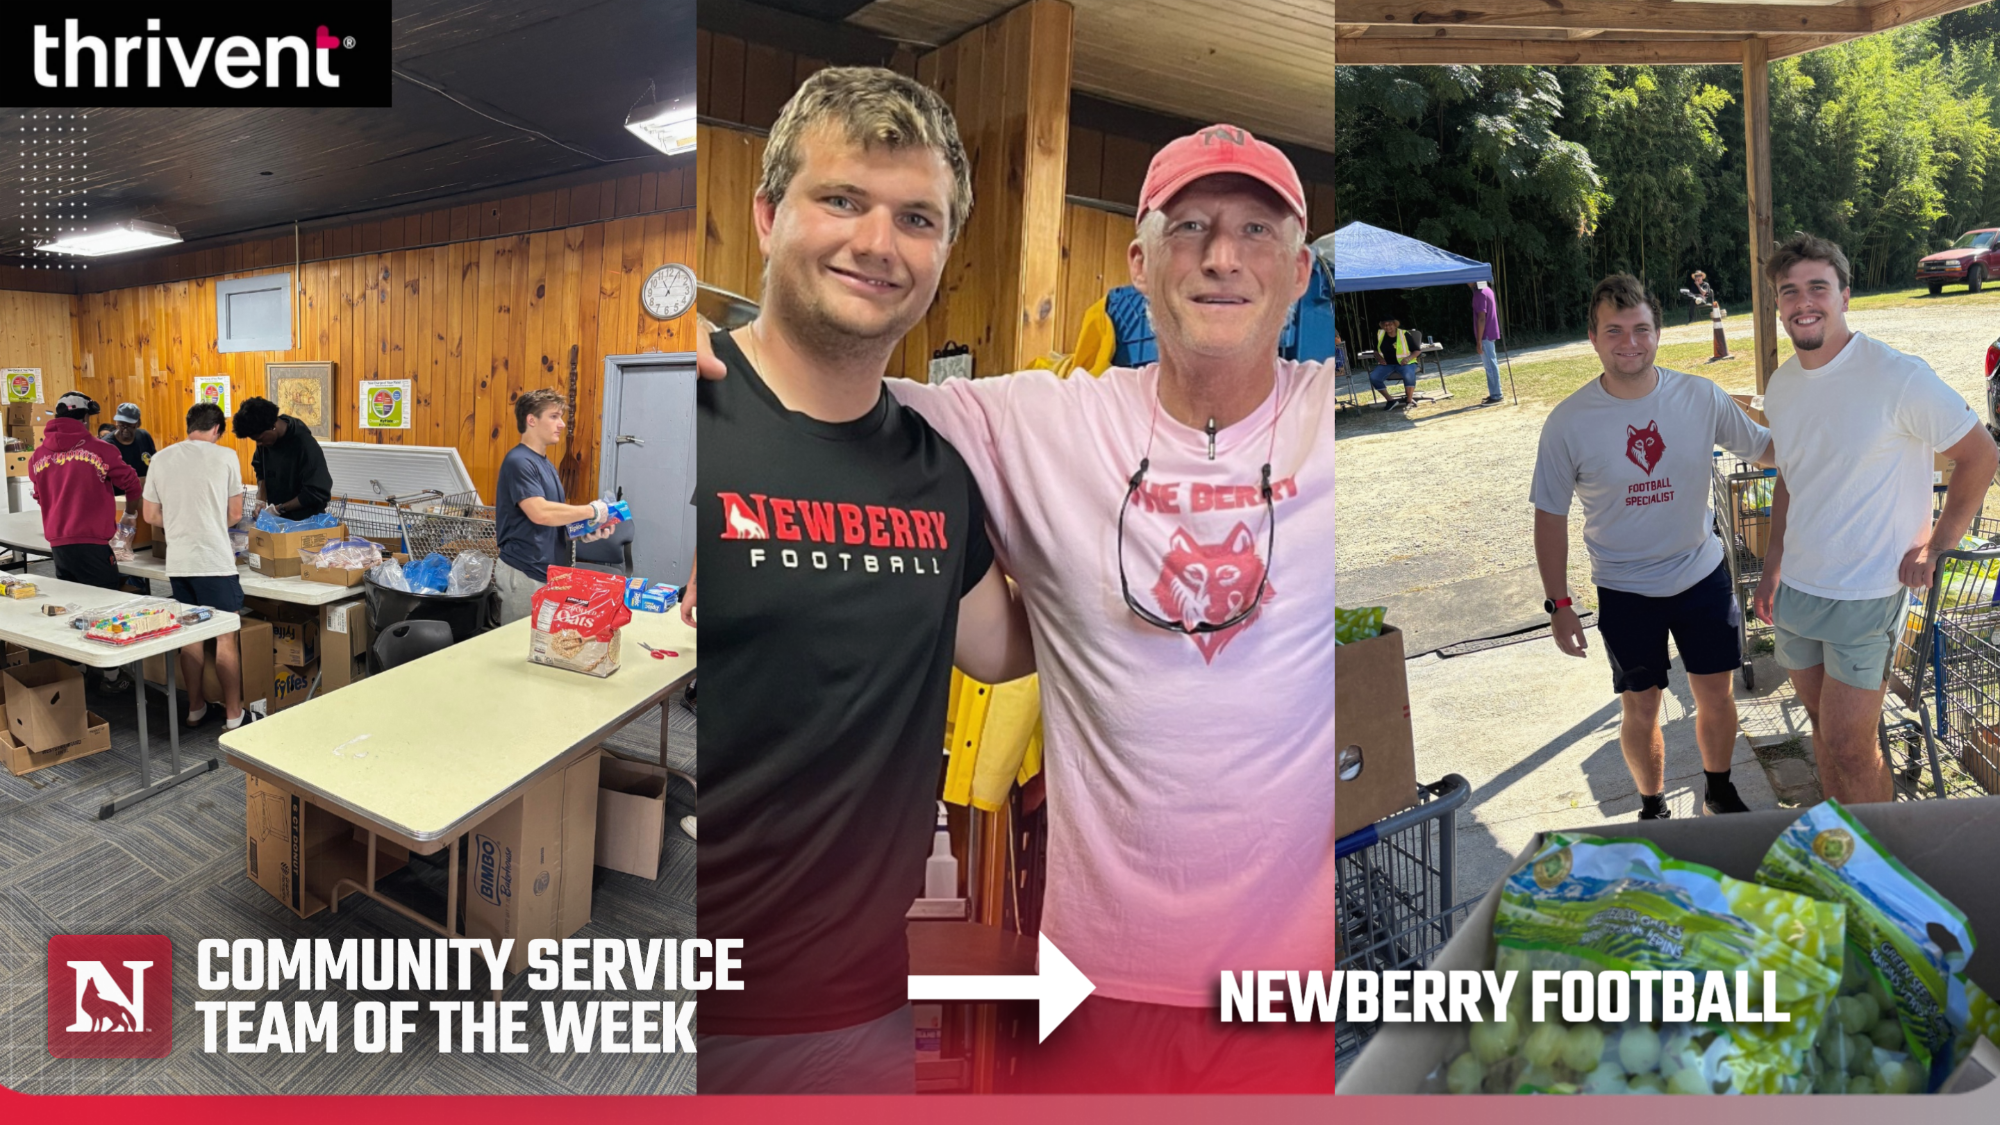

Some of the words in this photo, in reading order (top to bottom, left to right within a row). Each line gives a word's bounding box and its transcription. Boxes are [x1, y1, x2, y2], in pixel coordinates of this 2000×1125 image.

[666, 268, 674, 277] 12
[1126, 474, 1181, 514] HE
[1628, 477, 1672, 494] FOOTBALL
[1625, 490, 1675, 506] SPECIALIST
[717, 492, 948, 549] NEWBERRY
[750, 549, 940, 575] FOOTBALL
[556, 609, 595, 628] Oats
[292, 803, 298, 813] 6
[292, 815, 299, 832] CT
[480, 840, 495, 899] BIMBO
[500, 846, 512, 898] Bakehouse
